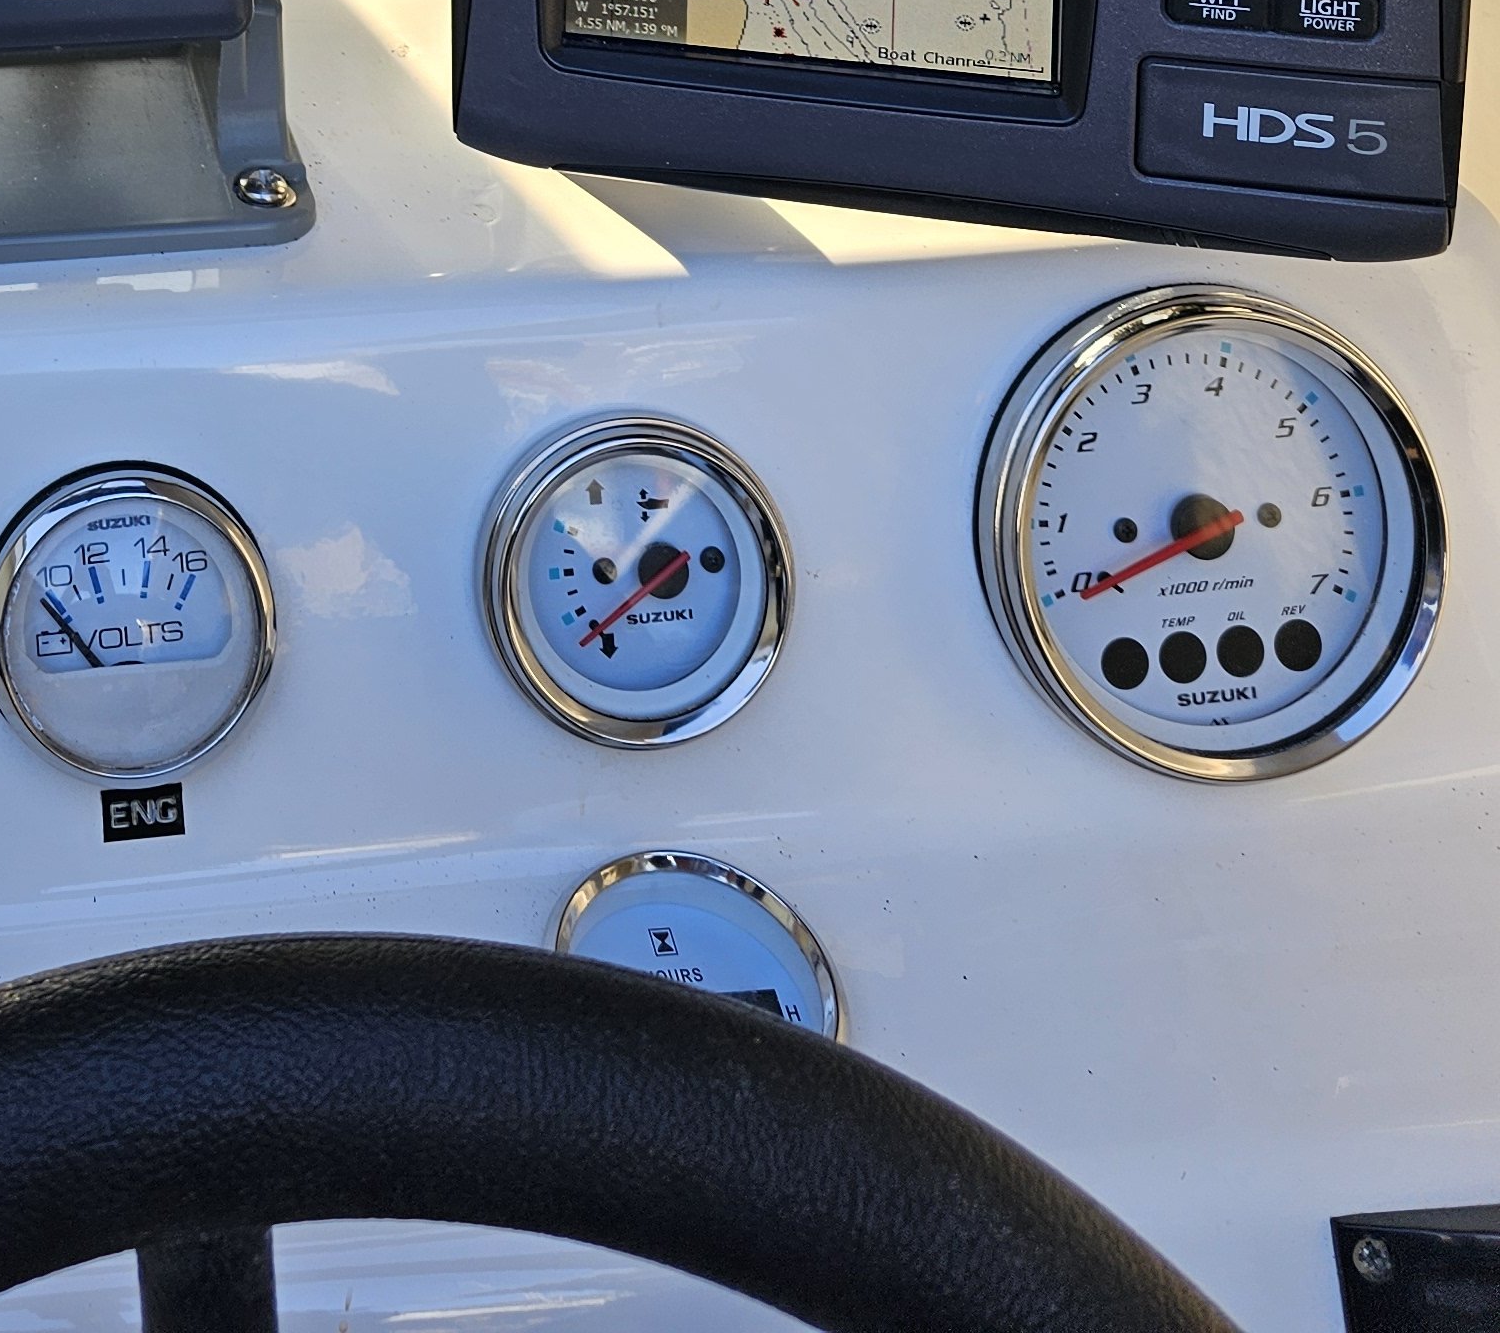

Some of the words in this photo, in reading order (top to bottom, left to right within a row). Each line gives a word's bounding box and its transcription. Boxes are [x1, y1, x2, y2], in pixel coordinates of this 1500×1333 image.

[575, 0, 588, 12] W
[1202, 7, 1237, 21] FIND
[575, 17, 602, 29] 4.55
[635, 23, 656, 34] 139
[1303, 17, 1355, 32] POWER
[878, 46, 916, 62] Boat
[985, 49, 1006, 62] 0.2
[1011, 52, 1030, 64] NM
[1202, 102, 1335, 150] HDS
[1346, 119, 1388, 156] 5
[1131, 384, 1152, 405] 3
[1205, 376, 1225, 397] 4
[1276, 417, 1297, 438] 5
[1077, 432, 1098, 453] 2
[1311, 486, 1332, 508] 6
[87, 515, 151, 532] SUZUKI
[1057, 513, 1068, 534] 1
[74, 541, 110, 564] 12
[134, 535, 170, 558] 14
[172, 550, 208, 573] 16
[37, 564, 73, 587] 10
[1212, 578, 1253, 591] r/min
[1309, 574, 1329, 595] 7
[626, 608, 694, 625] SUZUKI
[1227, 611, 1245, 621] OIL
[1281, 605, 1306, 616] REV
[1162, 616, 1195, 628] TEMP
[79, 621, 184, 650] VOLTS
[1177, 687, 1258, 707] SUZUKI
[110, 798, 177, 828] ENG
[651, 968, 703, 983] OURS
[785, 1005, 801, 1022] H
